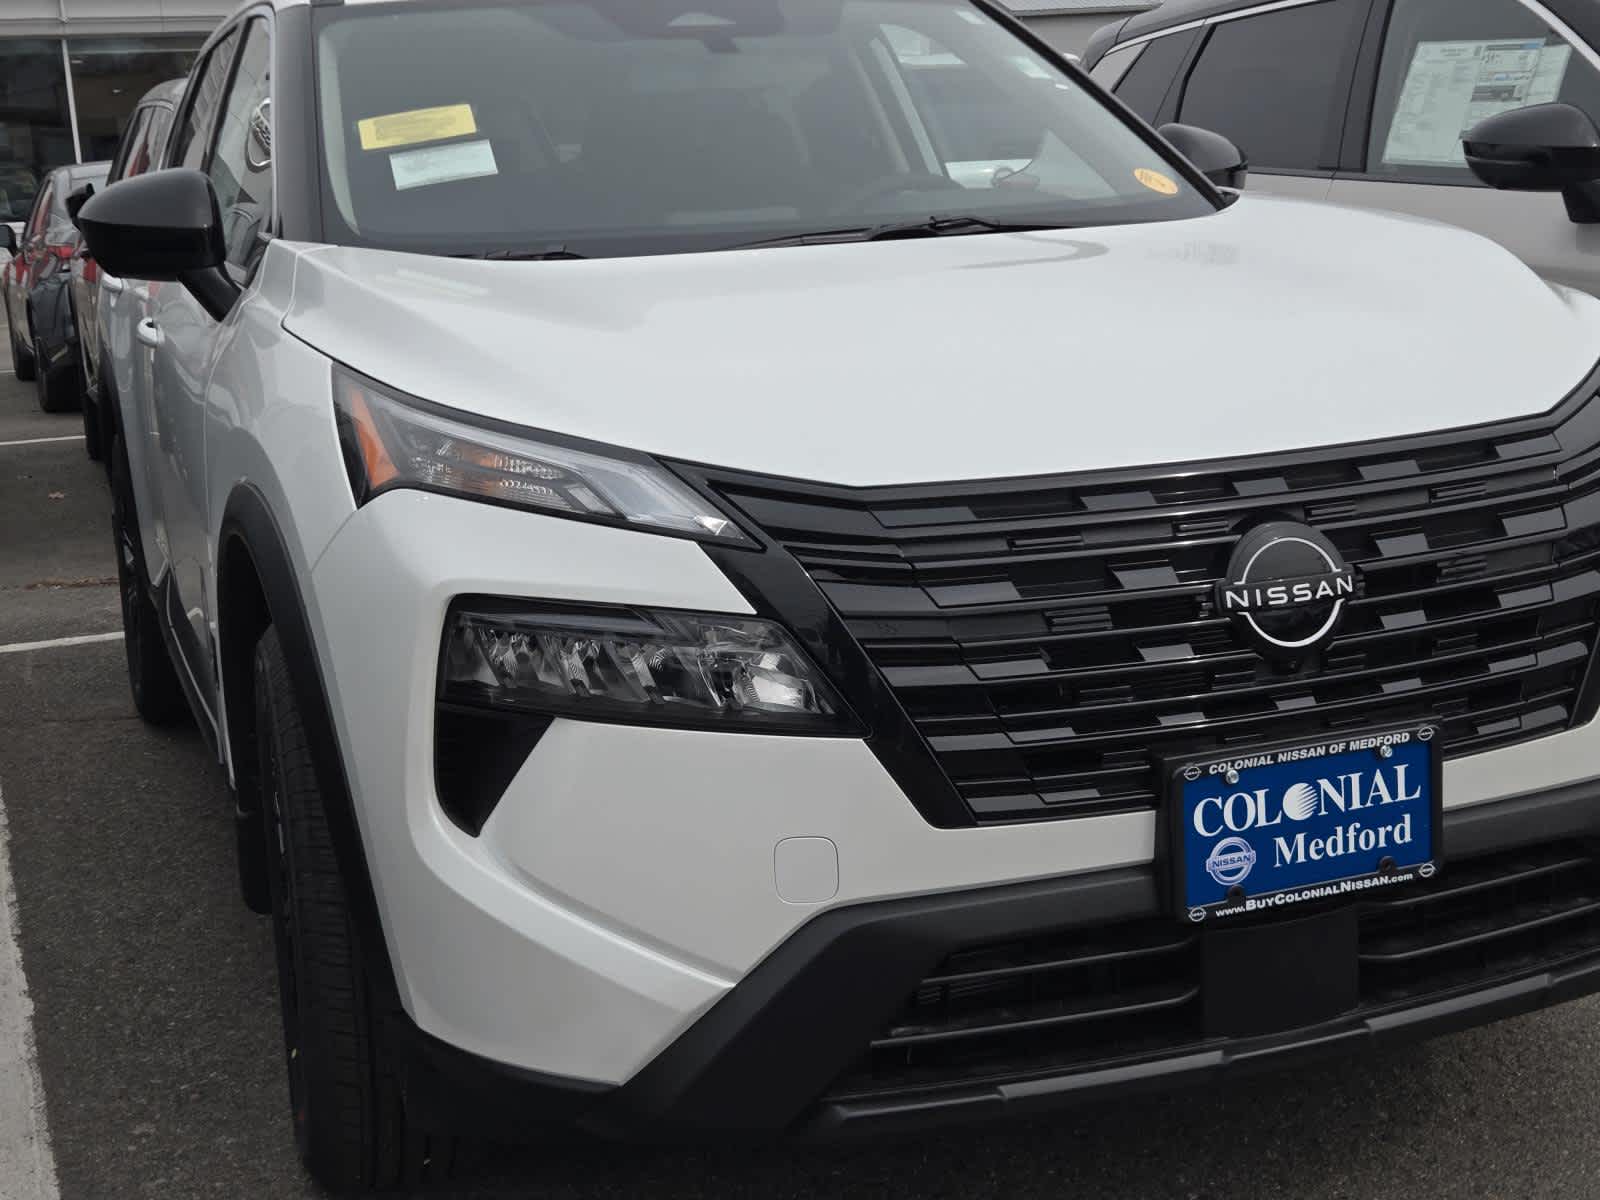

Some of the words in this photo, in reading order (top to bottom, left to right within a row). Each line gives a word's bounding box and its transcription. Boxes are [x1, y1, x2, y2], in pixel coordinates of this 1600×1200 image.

[1226, 576, 1353, 608] NISSAN
[1209, 757, 1274, 775] COLONIAL
[1277, 746, 1325, 762] NISSAN
[1328, 741, 1346, 754] OF
[1349, 732, 1410, 751] MEDFORD
[1193, 764, 1421, 837] COLONIAL
[1211, 855, 1252, 869] NISSAN
[1273, 813, 1413, 868] Medford
